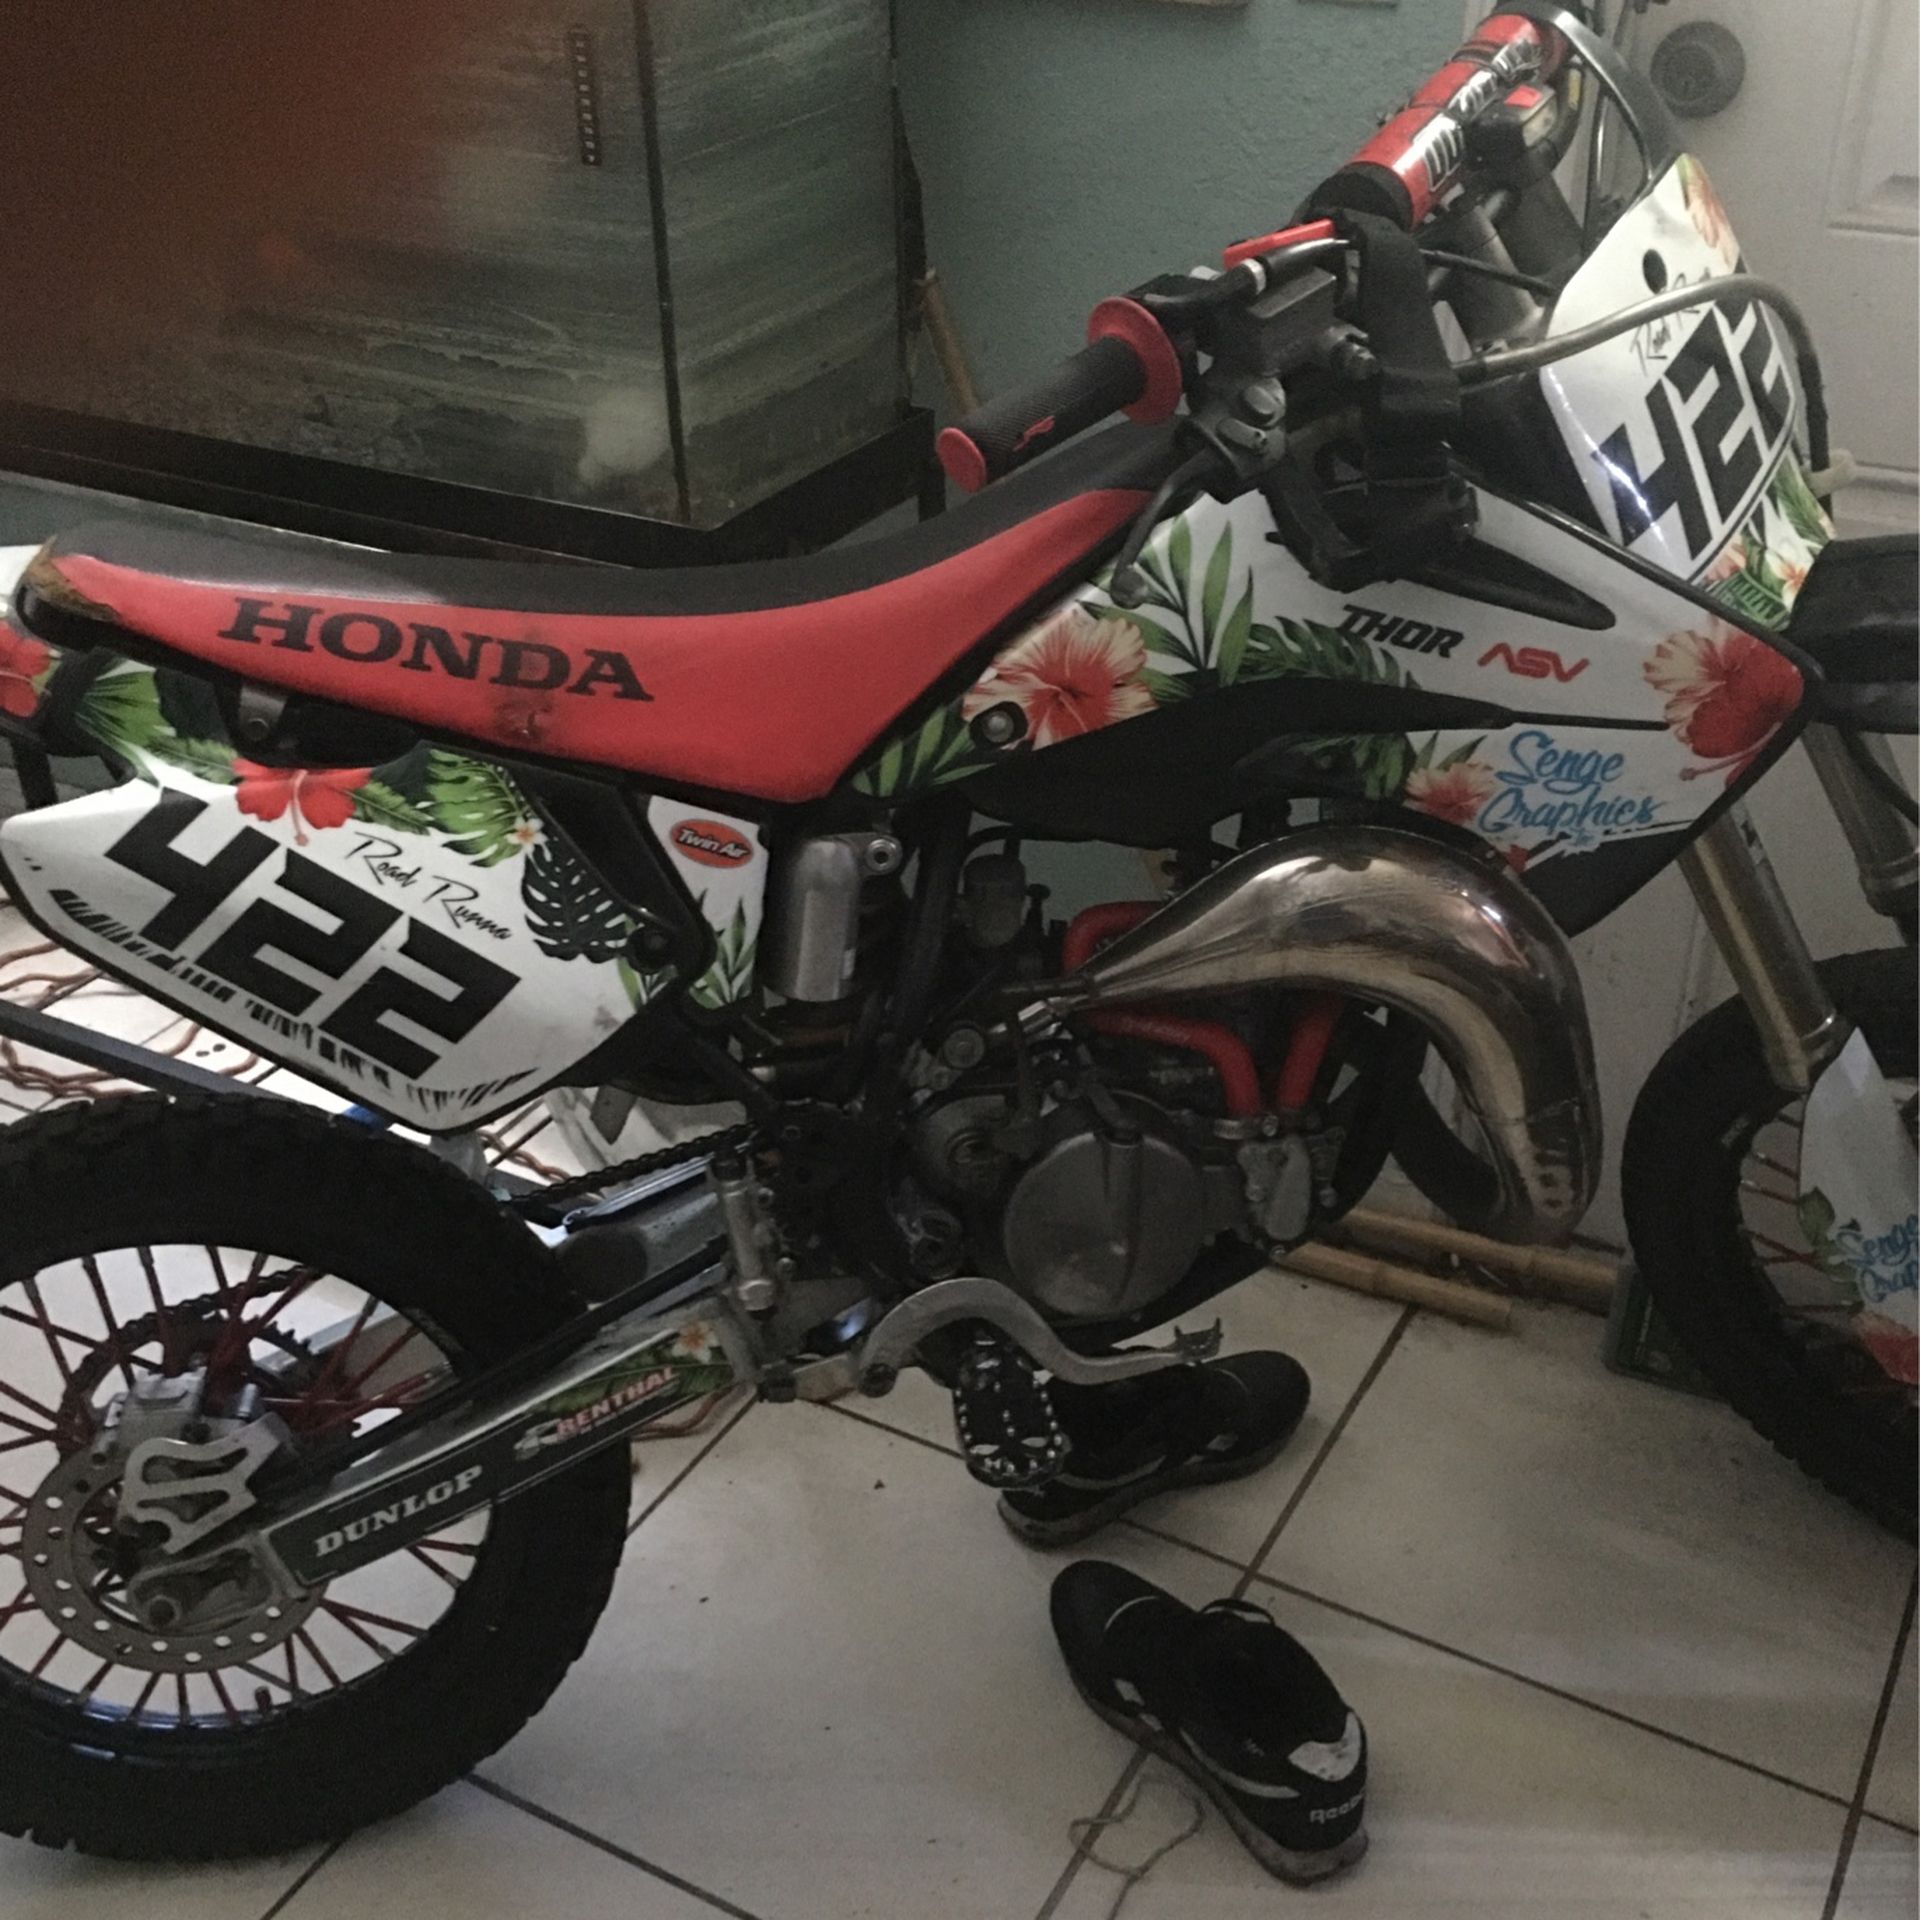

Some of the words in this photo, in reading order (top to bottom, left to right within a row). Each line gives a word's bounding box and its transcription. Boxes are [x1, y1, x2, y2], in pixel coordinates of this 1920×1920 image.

[1590, 262, 1793, 561] 422
[217, 597, 655, 703] HONDA
[1335, 603, 1465, 659] THOR
[1476, 642, 1590, 683] ASV
[1494, 730, 1625, 796] Senge
[678, 827, 720, 852] Twin
[718, 841, 750, 858] Air
[1478, 784, 1667, 836] Graphics
[344, 830, 423, 888] Road
[104, 786, 522, 1080] 422
[555, 1364, 680, 1437] RENTHAL
[313, 1464, 484, 1558] DUNLOP
